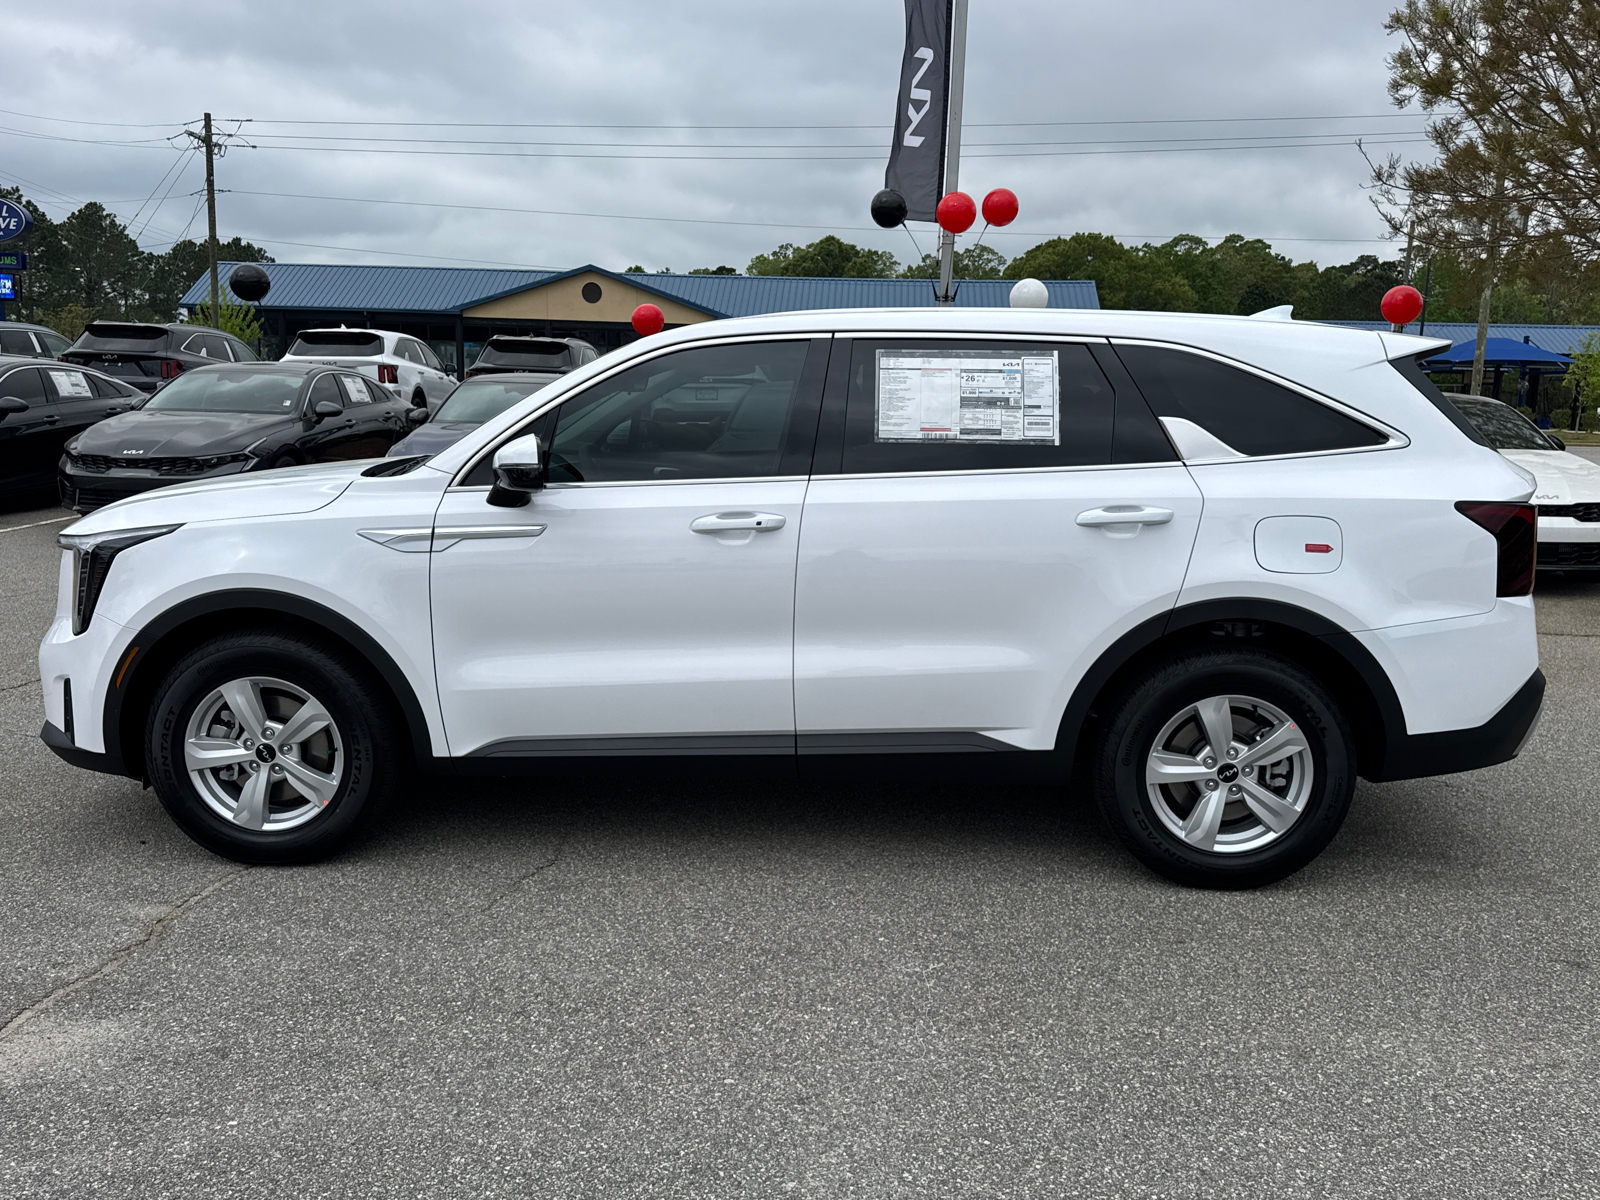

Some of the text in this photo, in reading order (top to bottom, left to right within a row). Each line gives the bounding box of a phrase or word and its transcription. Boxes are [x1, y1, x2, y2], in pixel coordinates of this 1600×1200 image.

[903, 46, 934, 148] KIA
[965, 374, 976, 382] 26
[1219, 767, 1238, 779] KIA
